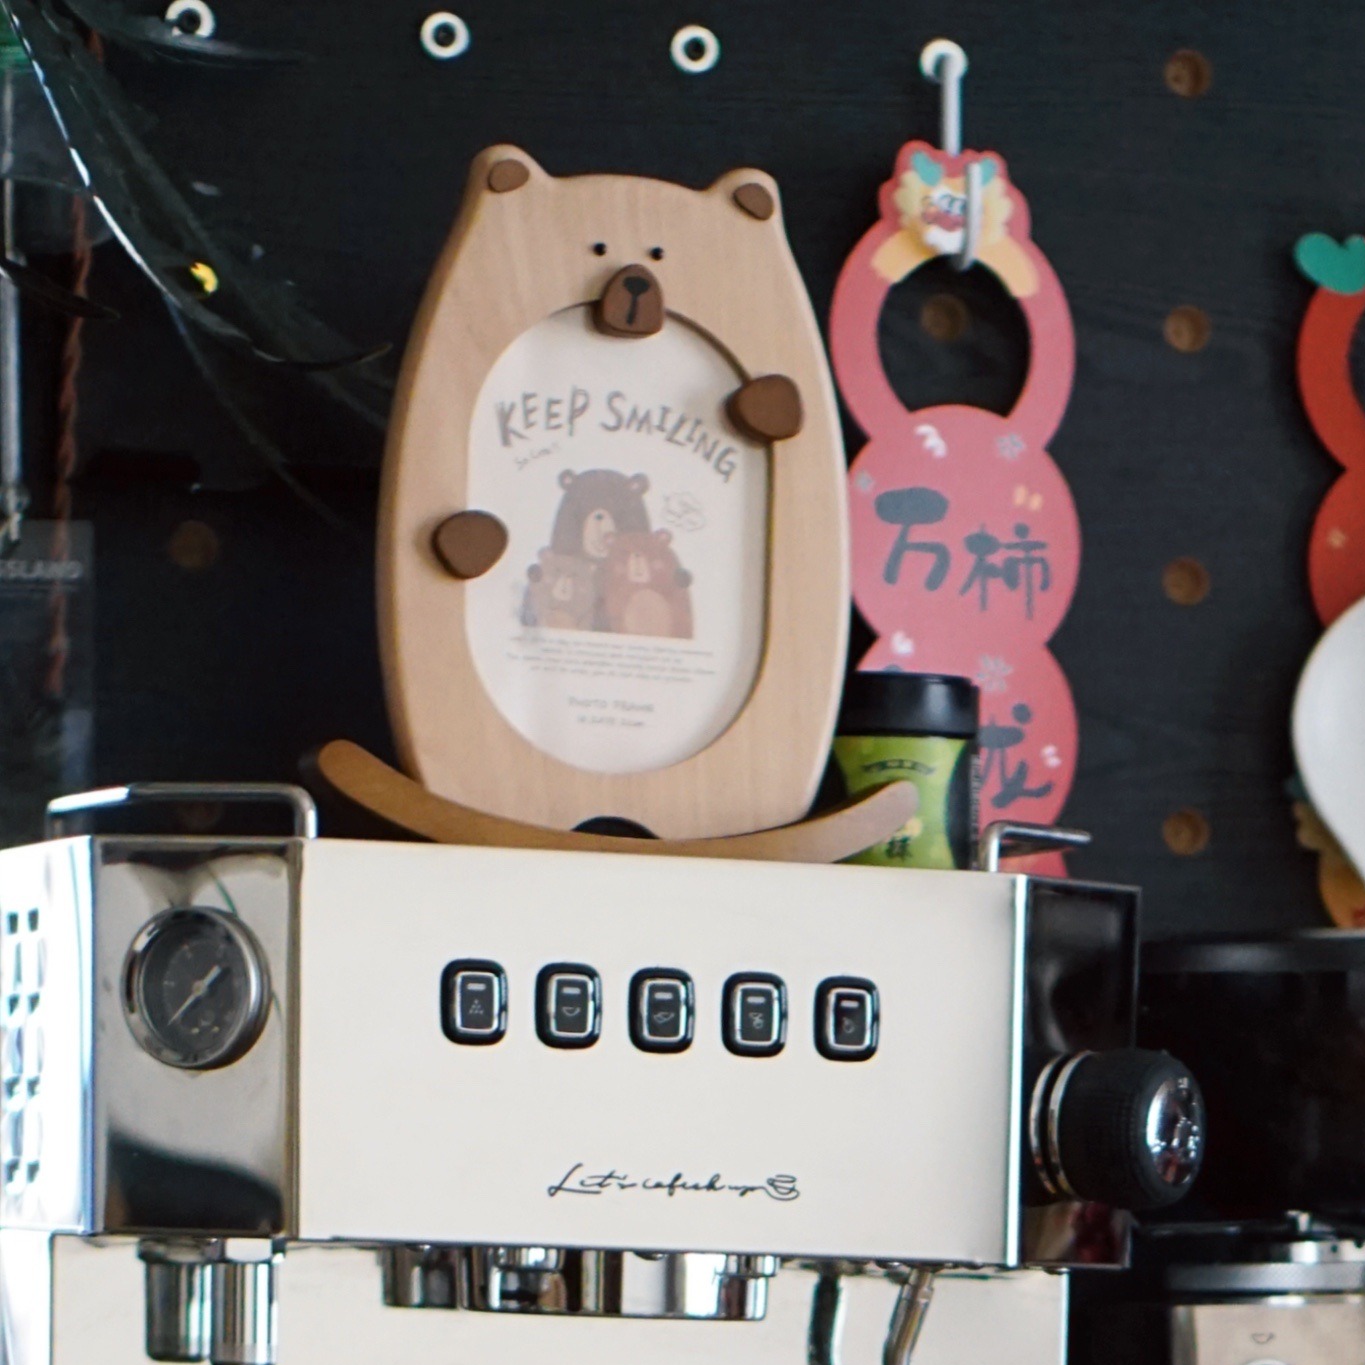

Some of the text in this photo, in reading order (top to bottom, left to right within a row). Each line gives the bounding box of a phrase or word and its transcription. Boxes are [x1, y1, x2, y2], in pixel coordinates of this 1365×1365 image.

[494, 385, 739, 483] KEEP SMILING
[873, 486, 1053, 623] 万柿
